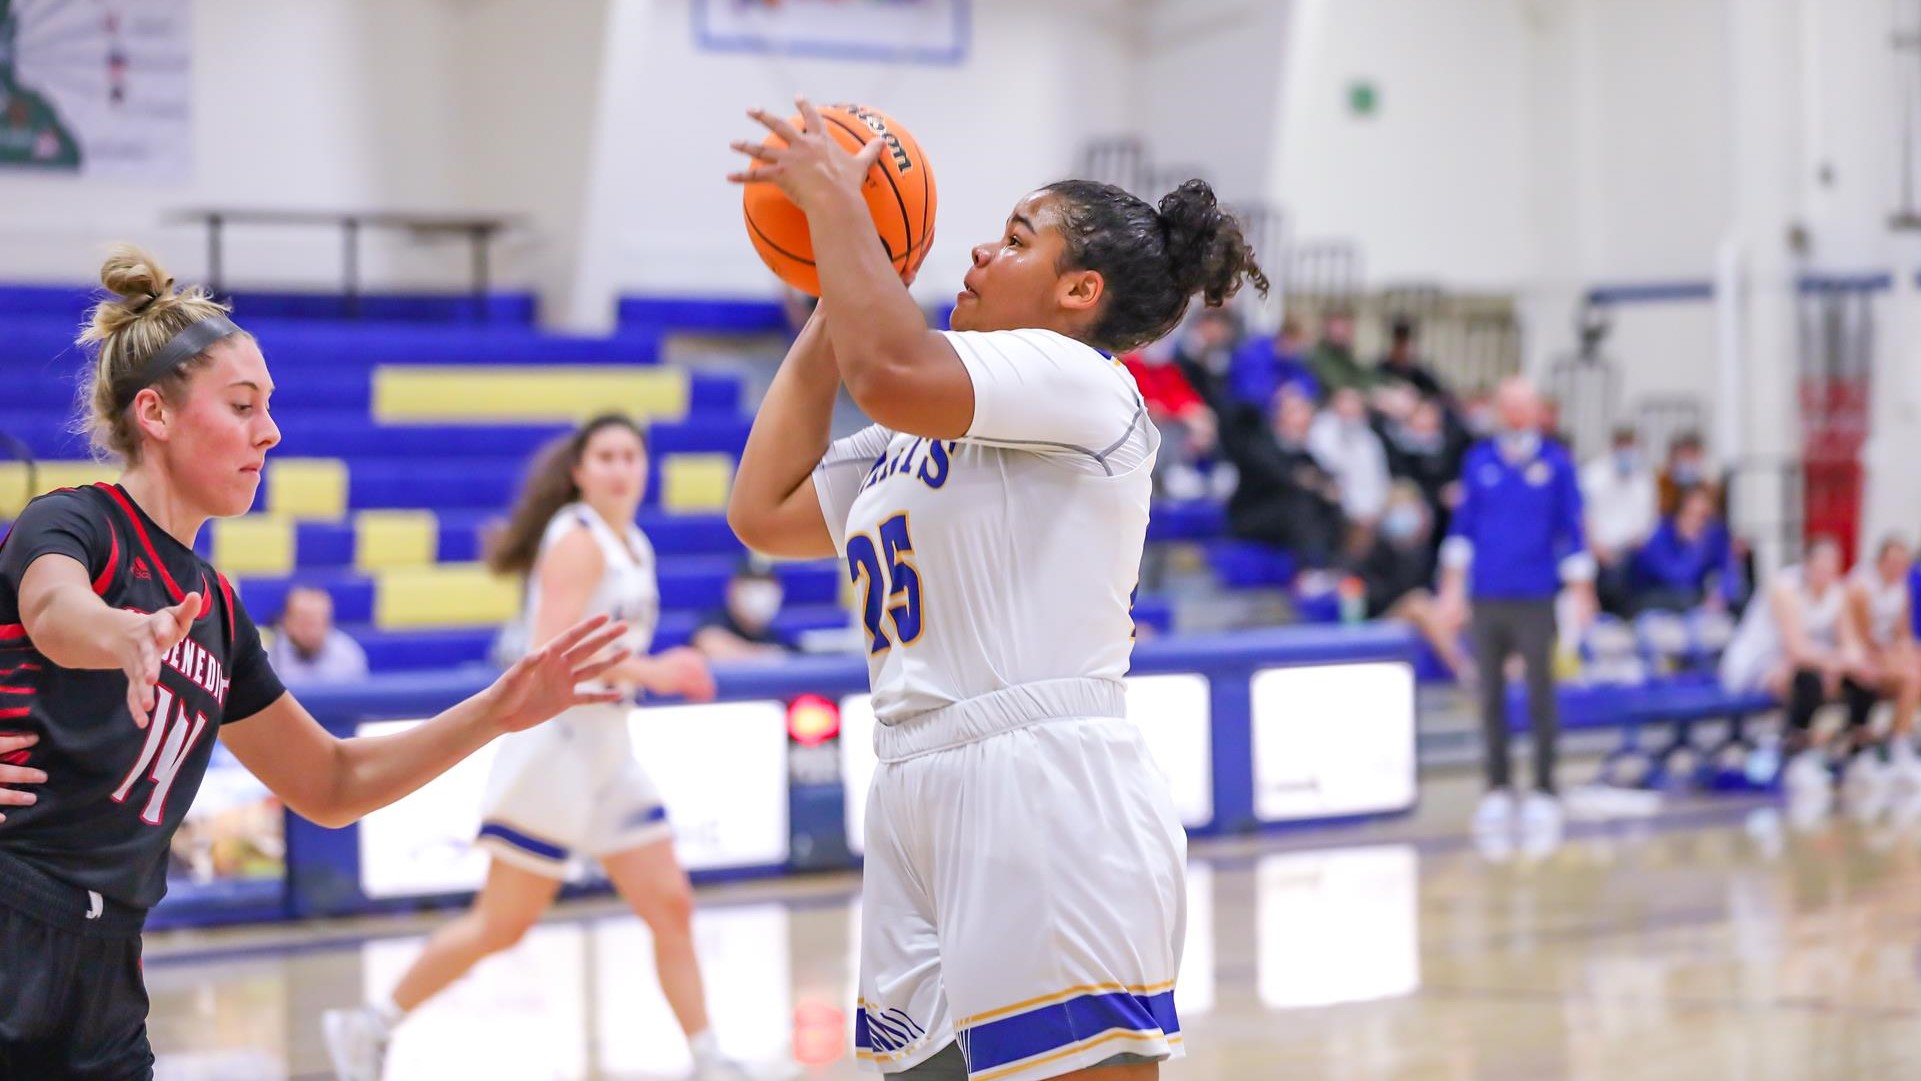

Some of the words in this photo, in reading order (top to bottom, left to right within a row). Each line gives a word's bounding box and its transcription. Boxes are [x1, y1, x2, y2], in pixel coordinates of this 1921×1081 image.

[846, 510, 925, 656] 25
[160, 636, 230, 706] ENEDI
[111, 682, 208, 825] 14
